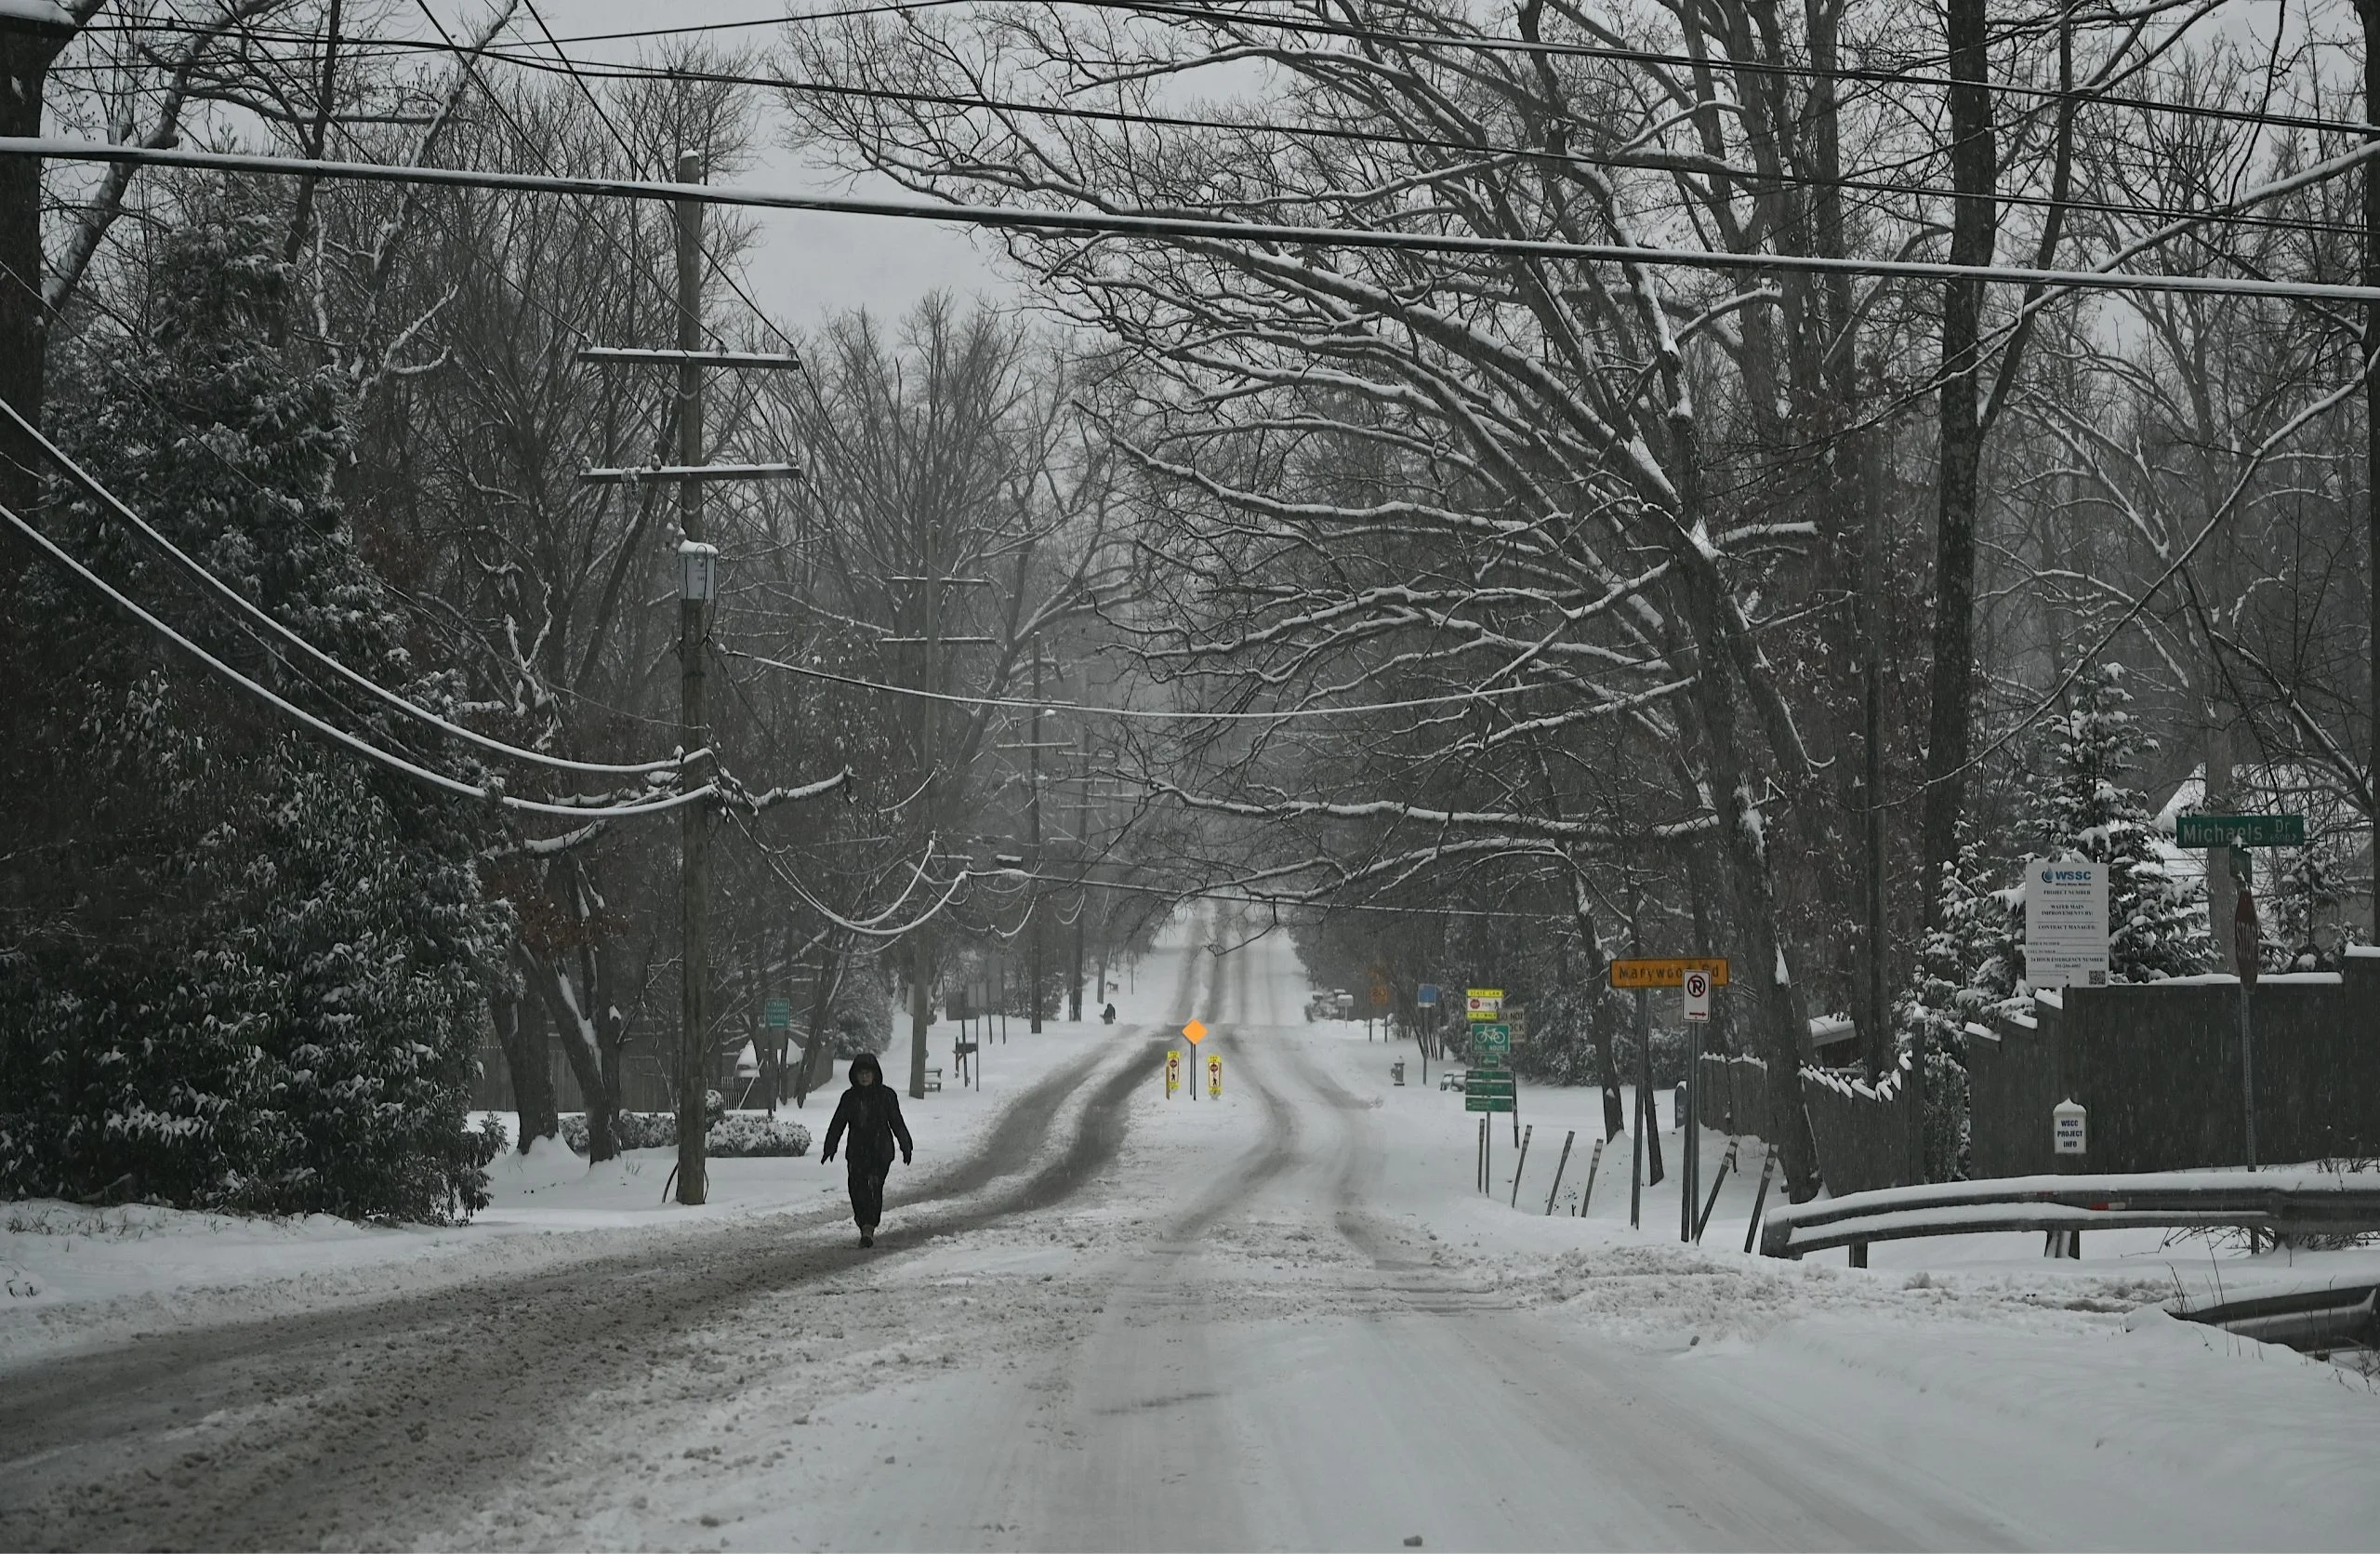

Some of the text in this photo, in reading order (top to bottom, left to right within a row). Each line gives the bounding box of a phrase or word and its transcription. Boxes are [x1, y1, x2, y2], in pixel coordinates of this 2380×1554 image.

[2183, 819, 2290, 843] Michaels Dr
[2055, 870, 2092, 881] WSSC
[2236, 921, 2257, 960] STOP
[1620, 965, 1690, 981] Marywoo
[1511, 1012, 1524, 1020] NOT
